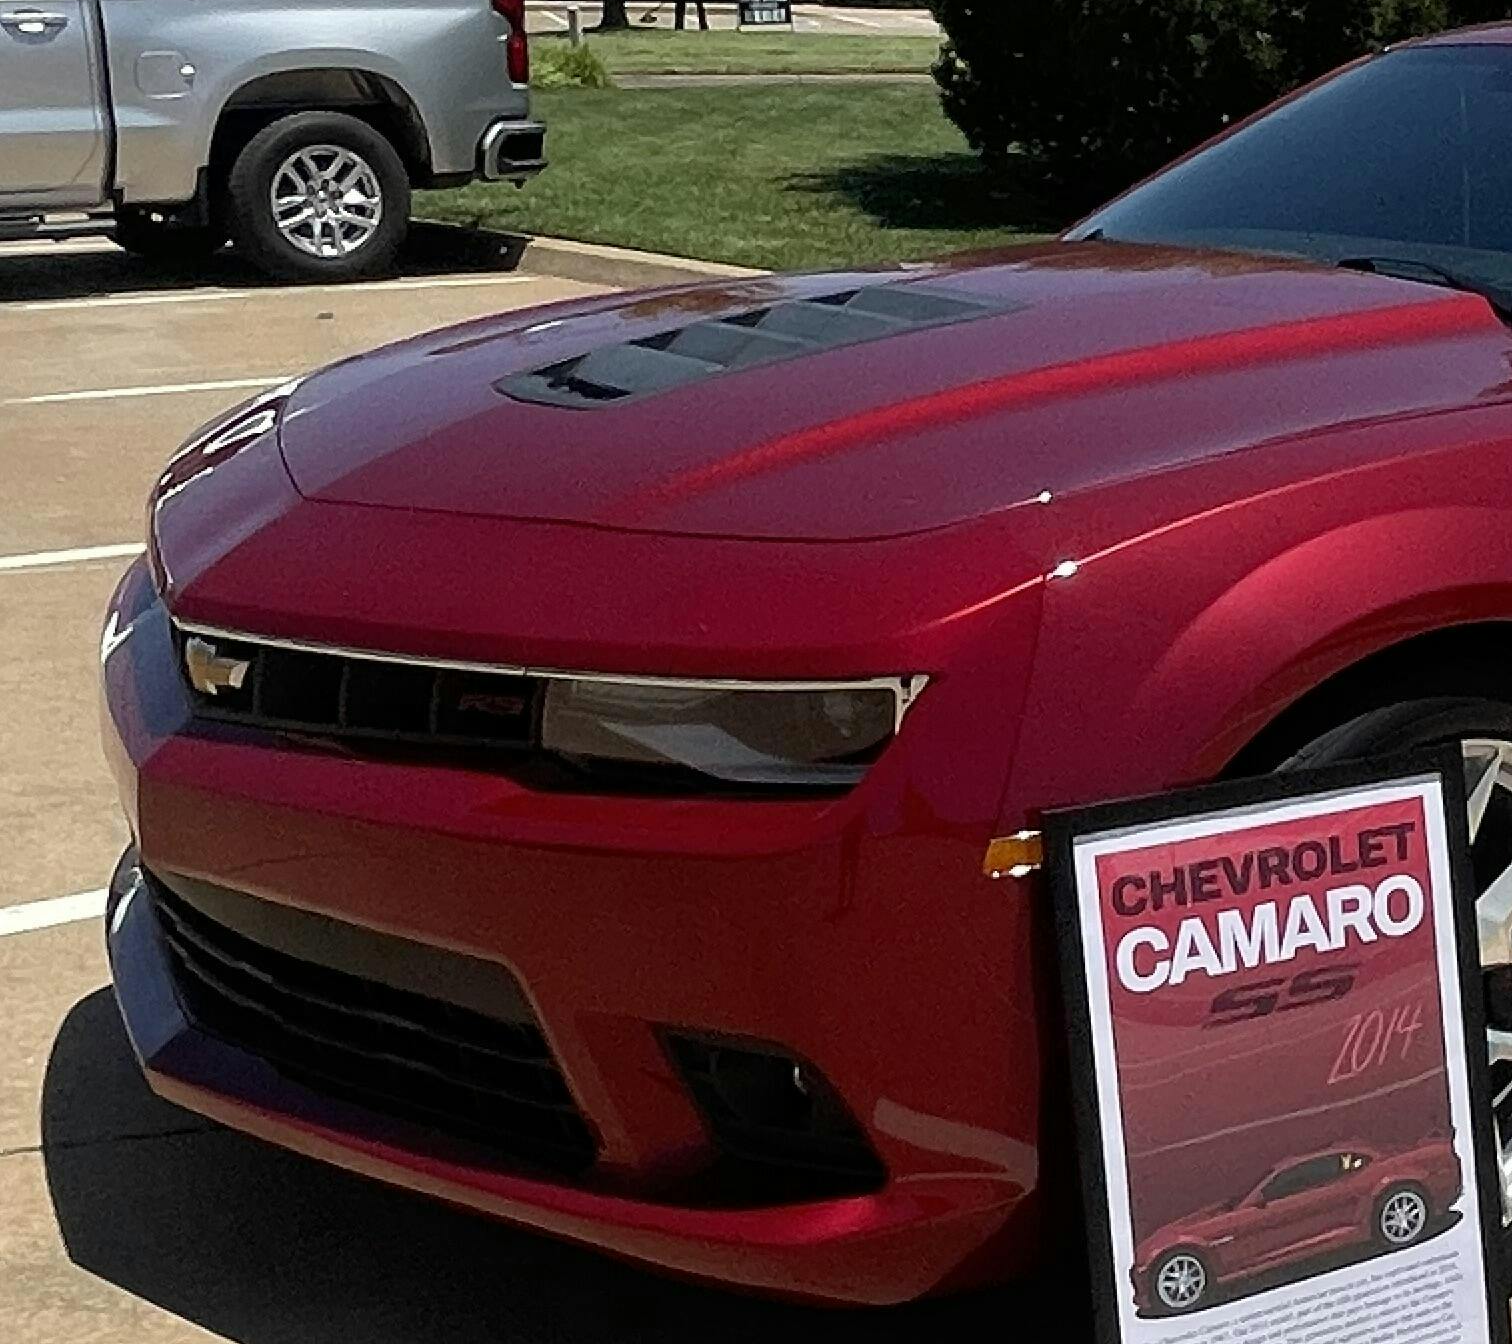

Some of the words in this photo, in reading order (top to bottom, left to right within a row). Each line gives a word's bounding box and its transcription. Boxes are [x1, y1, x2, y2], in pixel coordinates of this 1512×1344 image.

[1112, 822, 1416, 916] CHEVROLET
[1115, 873, 1425, 993] CAMARO
[1203, 963, 1360, 1030] SS
[1327, 1004, 1424, 1086] 2014
